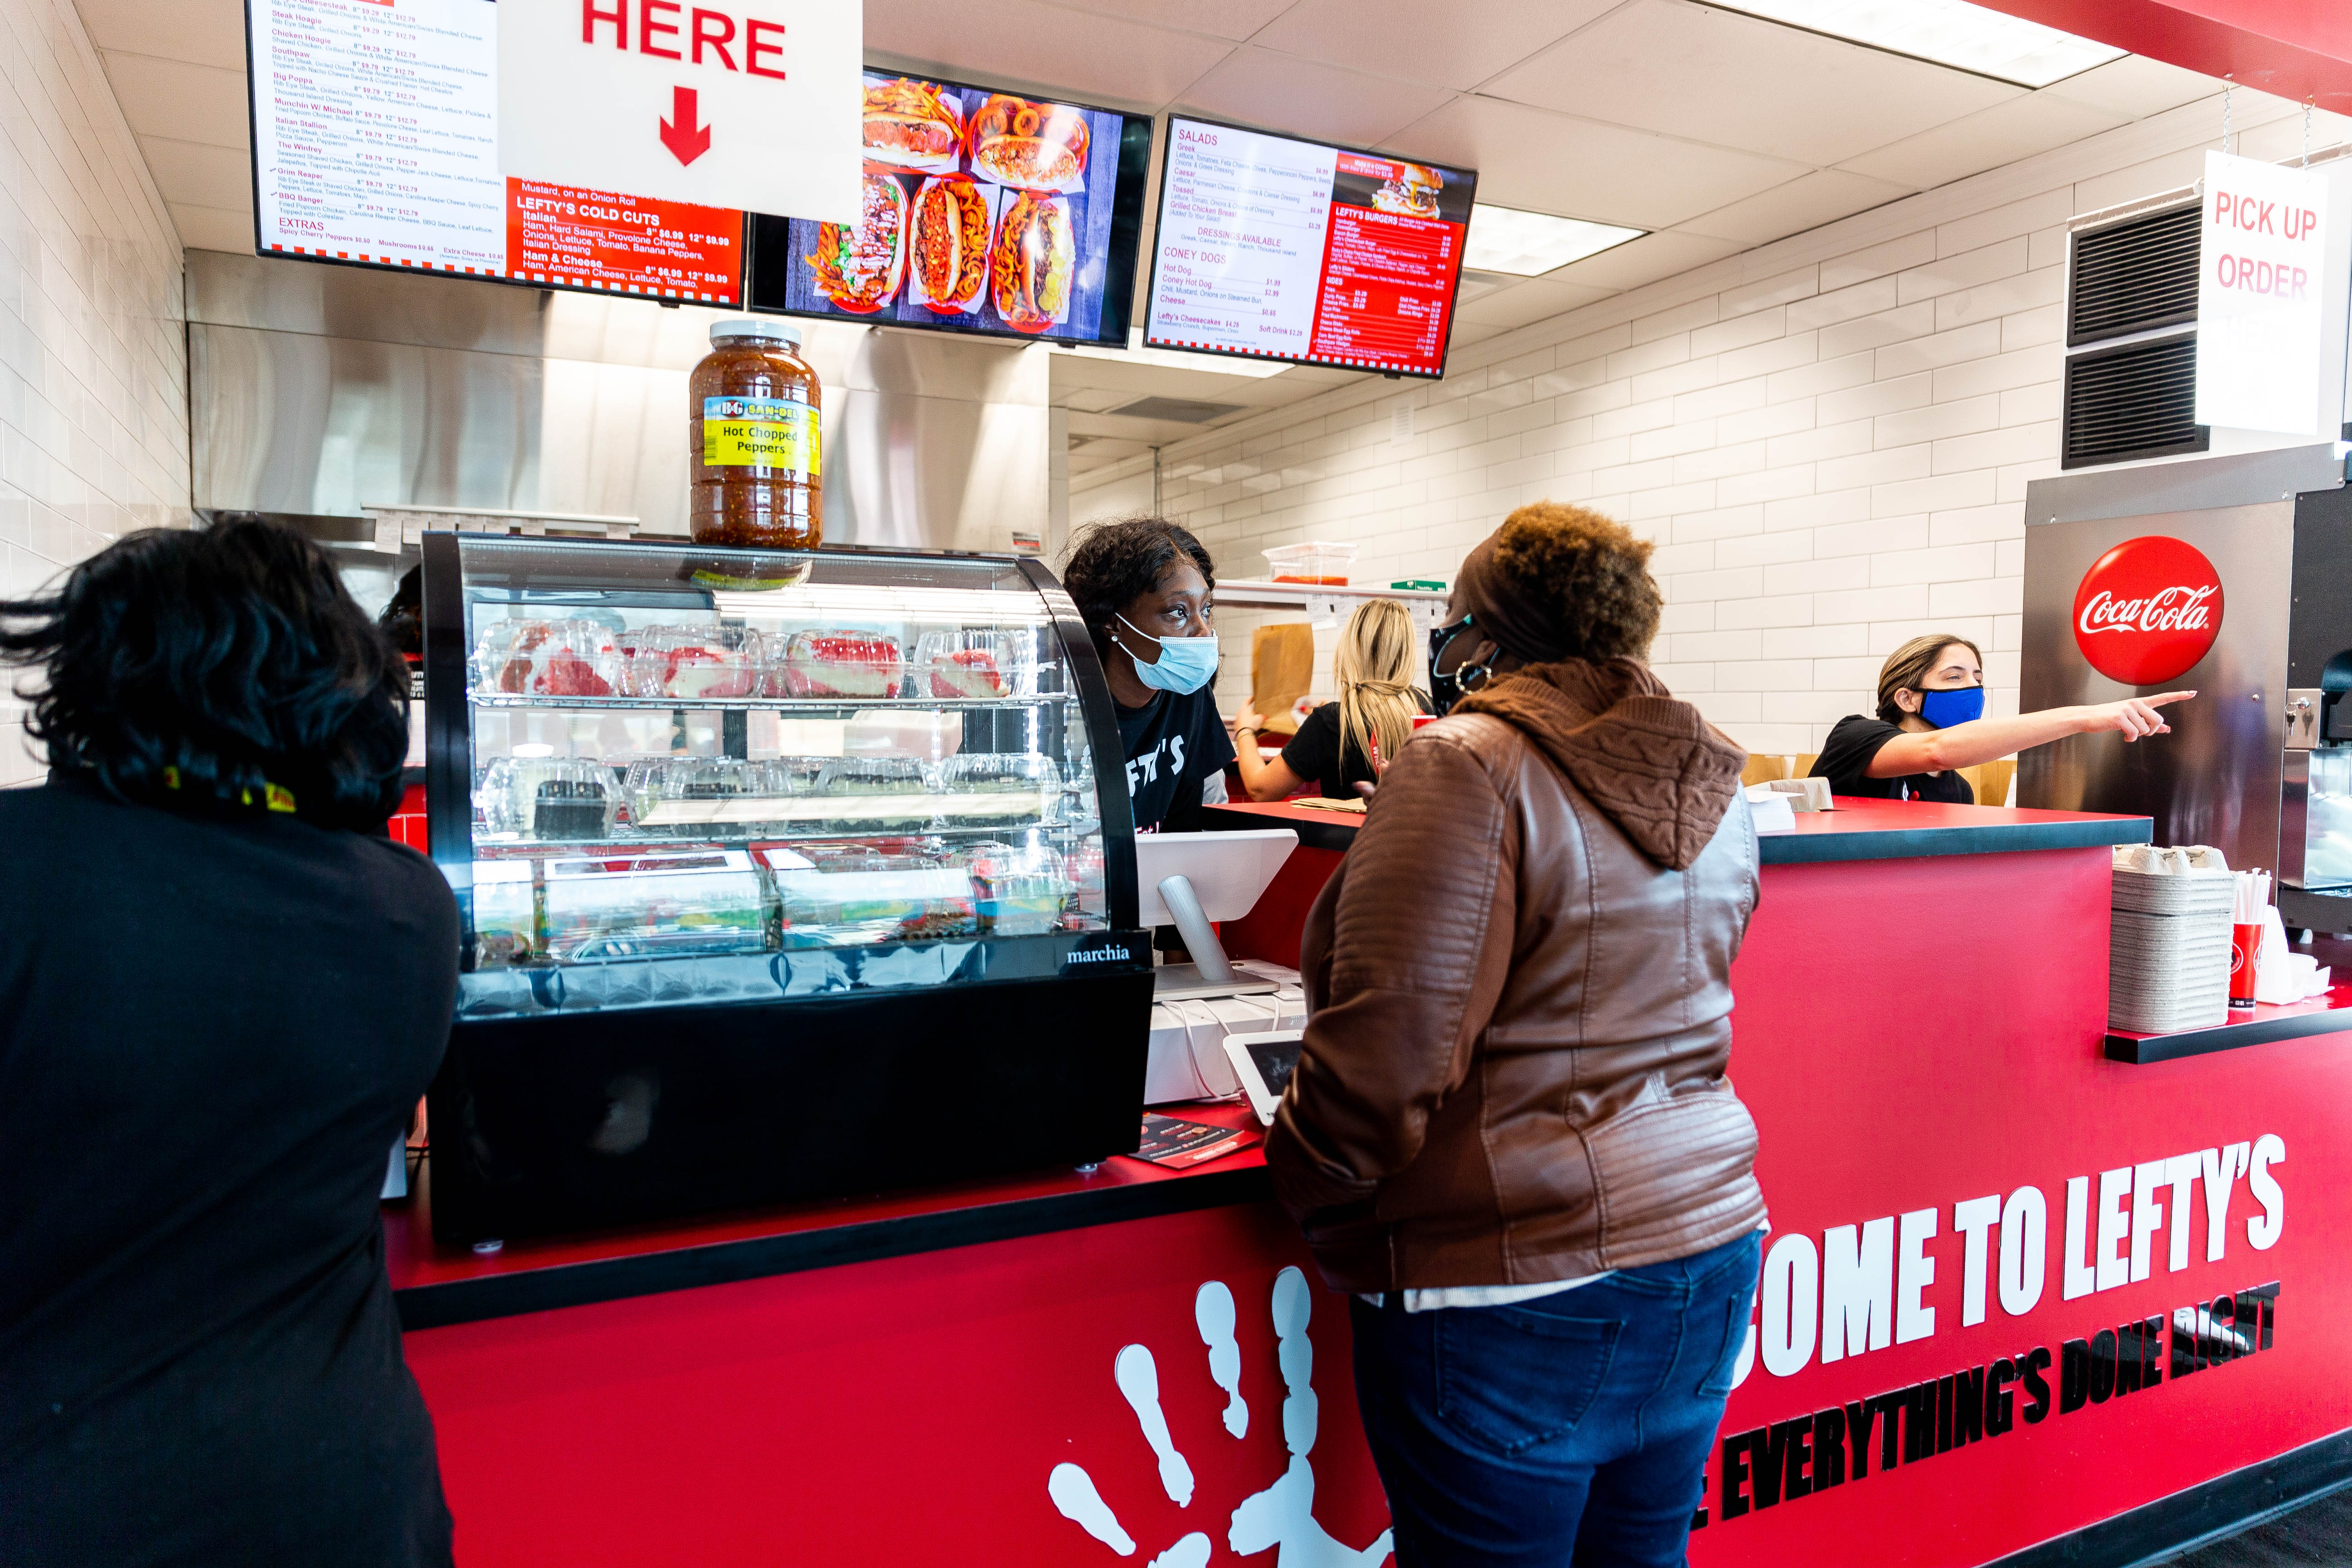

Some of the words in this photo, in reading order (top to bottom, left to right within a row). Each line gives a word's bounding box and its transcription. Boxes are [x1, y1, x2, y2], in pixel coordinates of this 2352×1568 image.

[272, 10, 293, 20] Steak
[295, 14, 322, 24] Hoagie
[272, 29, 303, 40] Chicken
[305, 34, 330, 44] Hoagie
[582, 0, 786, 81] HERE
[272, 46, 310, 58] Southpaw
[274, 72, 286, 81] Big
[289, 74, 313, 84] Poppa
[274, 97, 308, 109] Munchin
[323, 105, 352, 116] Michael
[275, 116, 298, 126] Italian
[300, 120, 327, 130] Stallion
[1178, 128, 1217, 146] SALADS
[278, 141, 291, 149] The
[294, 142, 322, 154] Winfrey
[1177, 142, 1195, 152] Greek
[278, 167, 295, 176] Grim
[298, 170, 323, 180] Reaper
[1174, 167, 1196, 177] Caesar
[522, 182, 560, 196] Mustard,
[590, 192, 616, 203] Onion
[619, 196, 635, 206] Roll
[1172, 184, 1194, 195] Tossed
[279, 192, 295, 201] BBQ
[298, 194, 323, 204] Banger
[517, 196, 575, 215] LEFTY'S
[579, 205, 619, 220] COLD
[622, 211, 659, 226] CUTS
[1170, 200, 1191, 211] Grilled
[1192, 204, 1216, 215] Chicken
[279, 216, 324, 231] EXTRAS
[1335, 207, 1363, 220] LEFTY'S
[1365, 212, 1397, 225] BURGERS
[2215, 191, 2276, 235] PICK
[2283, 206, 2317, 241] UP
[279, 226, 298, 236] Spicy
[300, 230, 323, 239] Cherry
[325, 232, 353, 241] Peppers
[523, 211, 556, 225] Italian
[646, 227, 657, 235] 8"
[659, 229, 683, 240] $6.99
[689, 233, 704, 242] 12"
[706, 235, 729, 246] $9.99
[523, 220, 546, 231] Ham,
[549, 224, 571, 234] Hard
[573, 227, 605, 239] Salami,
[608, 231, 651, 244] Provolone
[653, 237, 687, 249] Cheese,
[378, 239, 417, 250] Mushrooms
[1198, 227, 1240, 240] DRESSINGS
[1241, 234, 1281, 247] AVAILABLE
[523, 230, 558, 244] Onions,
[560, 234, 594, 247] Lettuce,
[597, 238, 630, 251] Tomato,
[633, 243, 665, 255] Banana
[668, 247, 704, 260] Peppers,
[523, 239, 549, 249] Italian
[552, 242, 590, 255] Dressing
[462, 249, 485, 258] Cheese
[1164, 246, 1197, 260] CONEY
[1200, 252, 1225, 264] DOGS
[523, 250, 548, 262] Ham
[551, 253, 559, 264] &
[562, 255, 603, 270] Cheese
[645, 266, 656, 274] 8"
[658, 267, 682, 278] $6.99
[687, 271, 702, 280] 12"
[704, 273, 727, 283] $9.99
[523, 260, 546, 270] Ham,
[548, 264, 589, 275] American
[592, 268, 627, 280] Cheese,
[630, 272, 663, 284] Lettuce,
[666, 277, 697, 288] Tomato,
[1163, 263, 1176, 273] Hot
[1178, 265, 1191, 275] Dog
[1162, 274, 1184, 286] Coney
[1185, 277, 1197, 287] Hot
[1199, 279, 1212, 290] Dog
[1326, 276, 1343, 286] SIDES
[2218, 254, 2308, 301] ORDER
[1160, 294, 1186, 305] Cheese
[1157, 311, 1179, 321] Lefty's
[1180, 314, 1220, 326] Cheesecakes
[1259, 324, 1271, 333] Soft
[1272, 326, 1288, 335] Drink
[748, 404, 799, 419] SAN-DEL
[723, 426, 744, 436] Hot
[749, 427, 798, 441] Chopped
[737, 441, 785, 454] Peppers
[2080, 584, 2219, 634] Coca-Cola
[1067, 944, 1130, 963] marchia
[1954, 1185, 2047, 1328] TO
[2062, 1133, 2286, 1301] LEFTY'S
[1721, 1345, 2051, 1521] EVERYTHING'S
[2059, 1313, 2164, 1415] DONE
[2171, 1280, 2281, 1380] RIGHT
